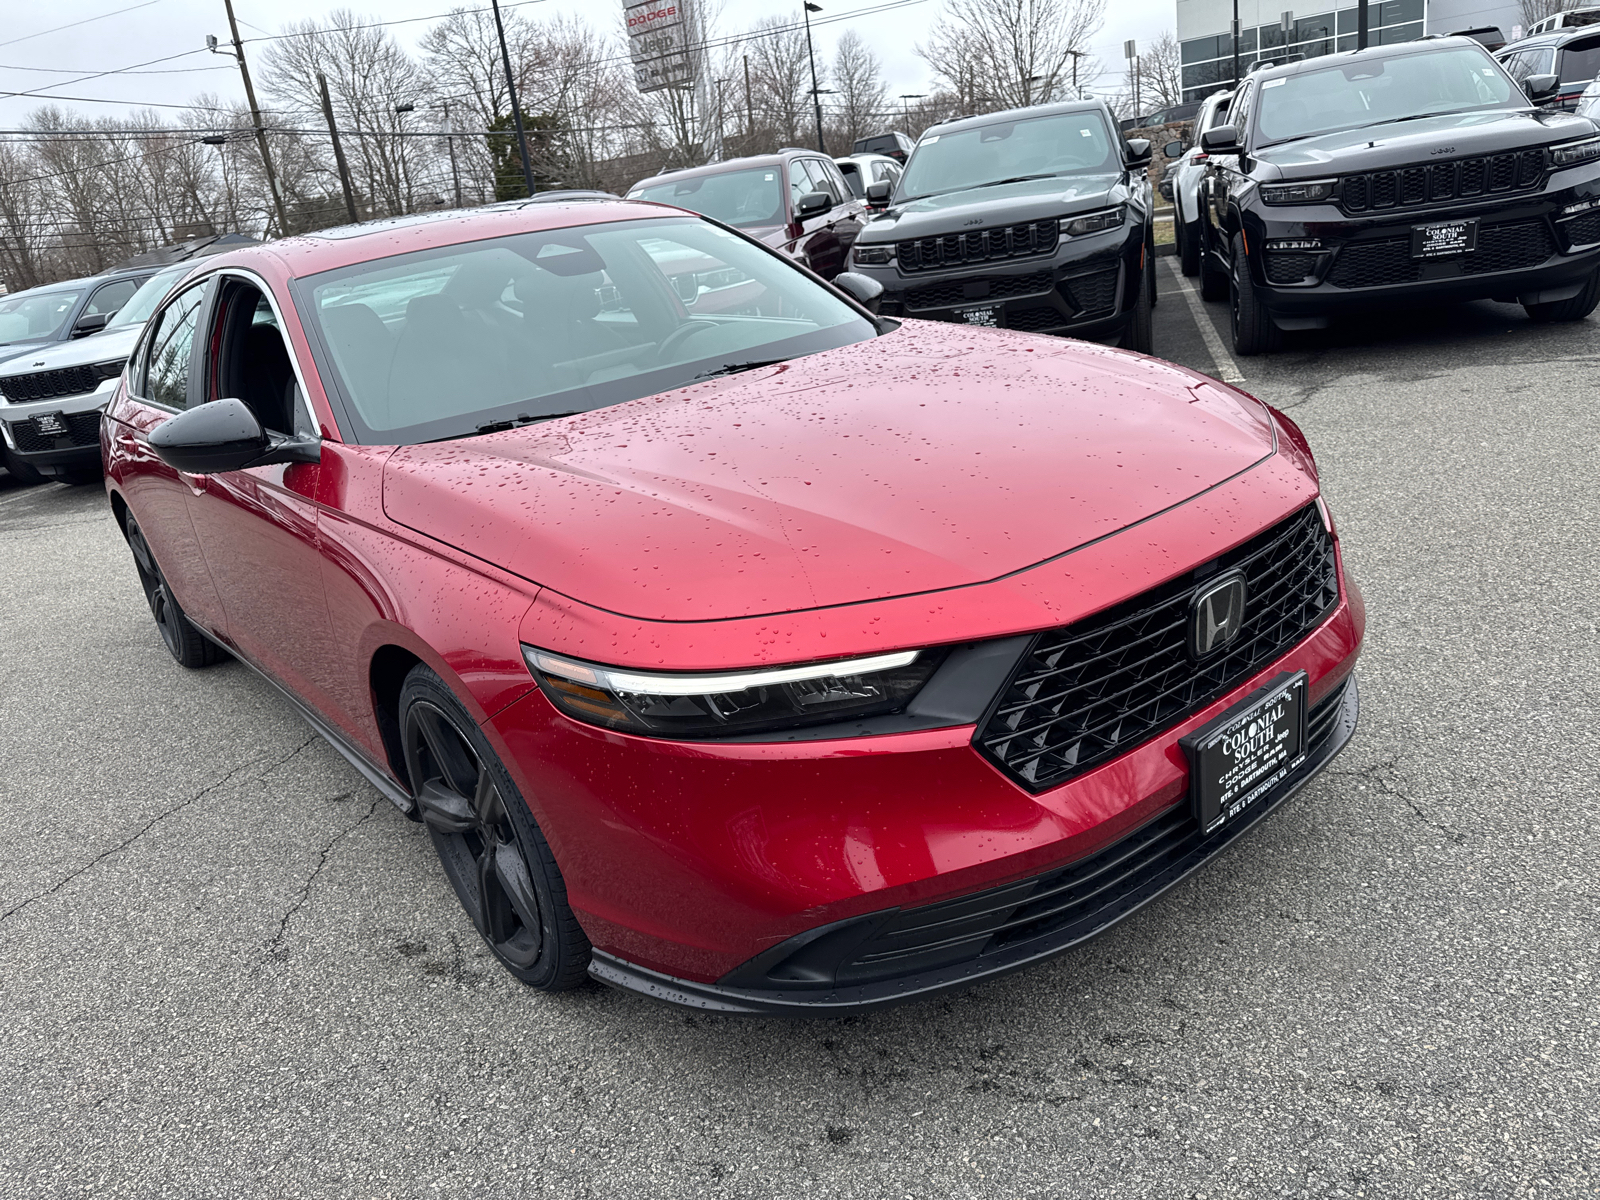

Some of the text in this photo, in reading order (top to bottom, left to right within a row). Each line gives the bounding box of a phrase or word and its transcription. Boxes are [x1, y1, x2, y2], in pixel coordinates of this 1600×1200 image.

[628, 6, 677, 27] DODGE
[1222, 703, 1285, 756] COLONIAL
[1234, 724, 1275, 764] SOUTH
[1218, 729, 1290, 784] CHRYSLER Jeep
[1220, 749, 1288, 804] RTE. 6 DARTMOUTH, MA
[1225, 743, 1283, 790] DODGE RAM
[1229, 804, 1242, 818] RTE.
[1241, 800, 1246, 808] 6
[1279, 767, 1287, 778] MA
